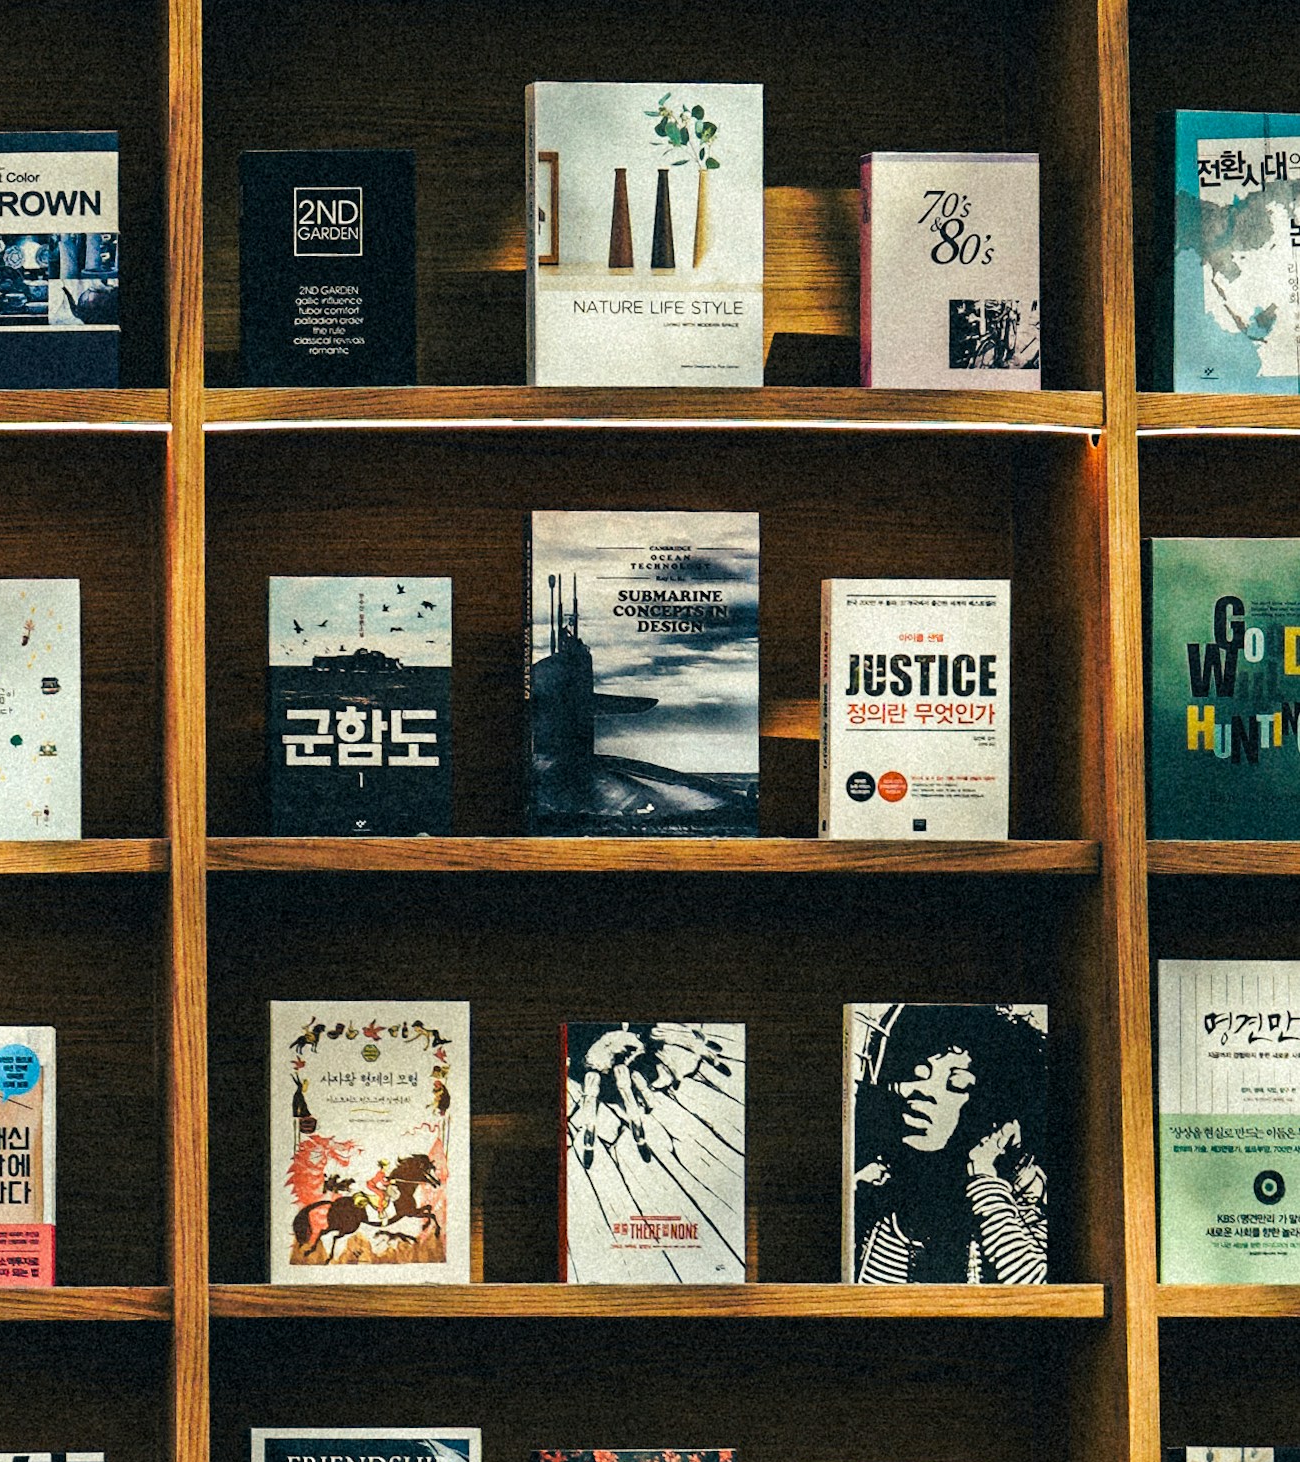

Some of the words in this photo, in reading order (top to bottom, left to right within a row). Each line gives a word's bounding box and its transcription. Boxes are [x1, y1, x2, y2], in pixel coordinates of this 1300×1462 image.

[5, 172, 40, 183] Color
[298, 200, 359, 224] 2ND
[298, 225, 359, 241] GARDEN
[573, 299, 643, 315] NATURE
[649, 300, 684, 316] LIFE
[692, 300, 744, 316] STYLE
[618, 590, 723, 603] SUBMARINE
[613, 605, 699, 618] CONCEPTS
[707, 605, 727, 617] IN
[638, 619, 702, 632] DESIGN
[845, 654, 997, 697] JUSTICE
[847, 703, 907, 725] 정의란
[916, 703, 995, 725] 무엇인가
[283, 706, 439, 766] 군함도
